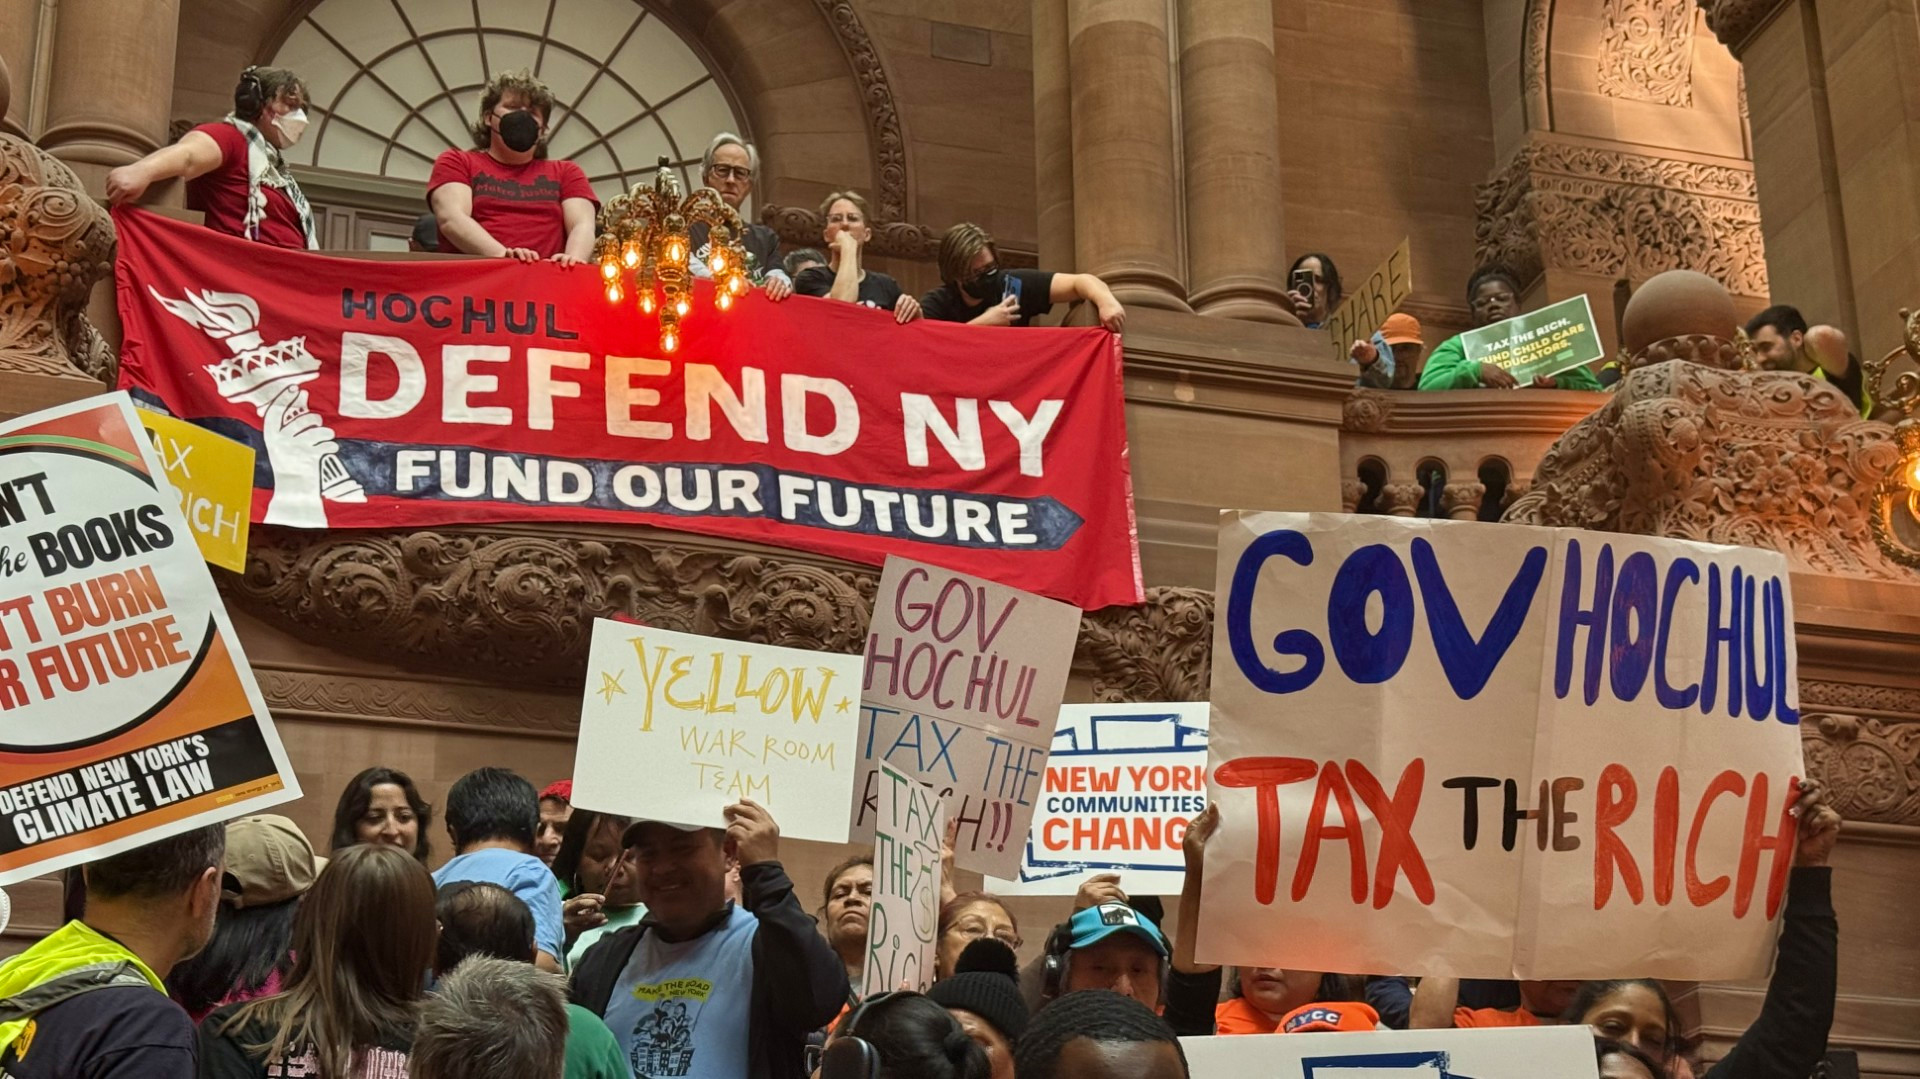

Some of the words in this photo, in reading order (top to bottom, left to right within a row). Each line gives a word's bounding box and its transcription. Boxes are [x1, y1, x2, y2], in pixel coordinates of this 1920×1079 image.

[341, 288, 579, 340] HOCHUL
[1329, 250, 1403, 361] SHARE
[1485, 337, 1511, 352] TAX
[1509, 330, 1536, 345] THE
[1536, 317, 1571, 336] RICH.
[1511, 336, 1550, 357] CHILD
[1551, 322, 1586, 341] CARE
[338, 331, 861, 456] DEFEND
[900, 391, 1065, 477] NY
[395, 450, 594, 504] FUND
[612, 464, 763, 513] OUR
[778, 473, 1038, 545] FUTURE
[27, 504, 174, 578] BOOKS
[43, 564, 168, 636] BURN
[895, 567, 1019, 653] GOV
[1226, 529, 1548, 700] GOV
[1554, 538, 1799, 725] HOCHUL
[26, 614, 192, 701] FUTURE
[626, 636, 838, 732] YELLOW
[863, 632, 1040, 728] HOCHUL
[0, 772, 79, 816] DEFEND
[79, 756, 131, 792] NEW
[131, 734, 209, 775] YORK'S
[680, 725, 756, 758] WAR
[763, 734, 835, 771] ROOM
[691, 762, 771, 806] TEAM
[860, 704, 957, 783] TAX
[983, 736, 1044, 807] THE
[1046, 767, 1121, 792] NEW
[12, 780, 147, 846] CLIMATE
[146, 758, 215, 807] LAW
[856, 769, 1013, 854] RH!!
[881, 764, 942, 850] TAX
[1047, 796, 1205, 814] COMMUNITIES
[1213, 757, 1436, 910] TAX
[1441, 776, 1584, 852] THE
[1594, 763, 1802, 922] RICH
[876, 830, 914, 903] THE
[637, 985, 663, 996] MAKE
[664, 981, 684, 991] THE
[669, 988, 686, 997] NEW
[687, 987, 706, 998] YORK
[1285, 1010, 1339, 1033] NYCC
